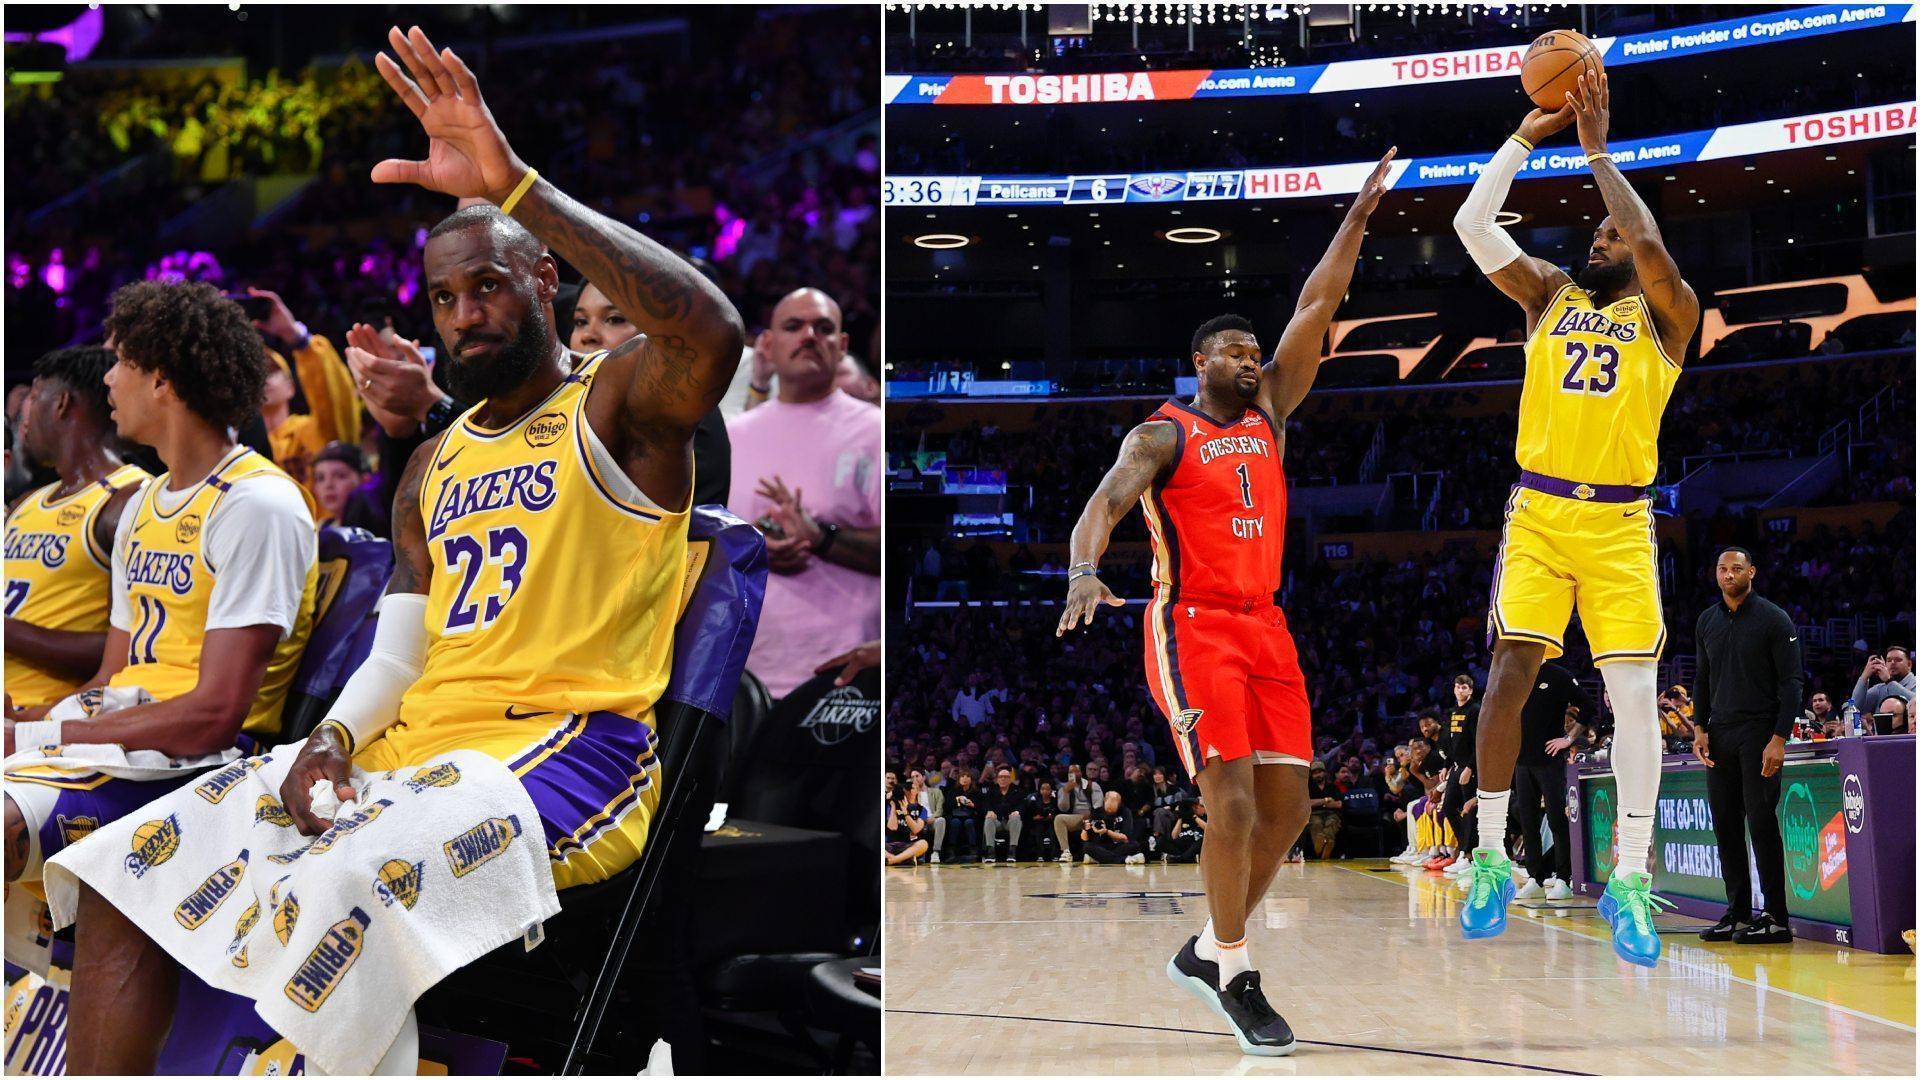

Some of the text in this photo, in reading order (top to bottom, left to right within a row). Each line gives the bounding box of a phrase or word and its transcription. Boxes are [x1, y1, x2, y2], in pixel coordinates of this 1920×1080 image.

[1623, 5, 1886, 56] Printer Provider of Crypto.com Arena
[1392, 51, 1522, 80] TOSHIBA
[984, 73, 1155, 103] TOSHIBA
[1252, 75, 1295, 90] Arena
[1419, 163, 1466, 179] Printer
[1530, 157, 1547, 170] of
[1638, 144, 1681, 161] Arena
[990, 179, 1108, 200] Pelicans 6
[1196, 183, 1233, 197] 2 7
[1550, 307, 1637, 342] LAKERS
[1562, 342, 1620, 395] 23
[529, 421, 566, 435] bibigo
[1200, 436, 1269, 465] CRESCENT
[427, 460, 559, 543] LAKERS
[1236, 463, 1254, 508] 1
[1232, 516, 1264, 539] CITY
[1324, 545, 1347, 557] 116
[443, 527, 530, 634] 23
[130, 595, 166, 666] 11
[798, 698, 880, 733] LAKERS
[1659, 799, 1676, 829] THE
[1677, 799, 1706, 831] GO-TO
[452, 820, 500, 869] PRIME
[1664, 842, 1676, 873] OF
[1677, 843, 1712, 878] LAKERS
[181, 870, 235, 921] PRIME
[292, 929, 355, 1000] PRIME
